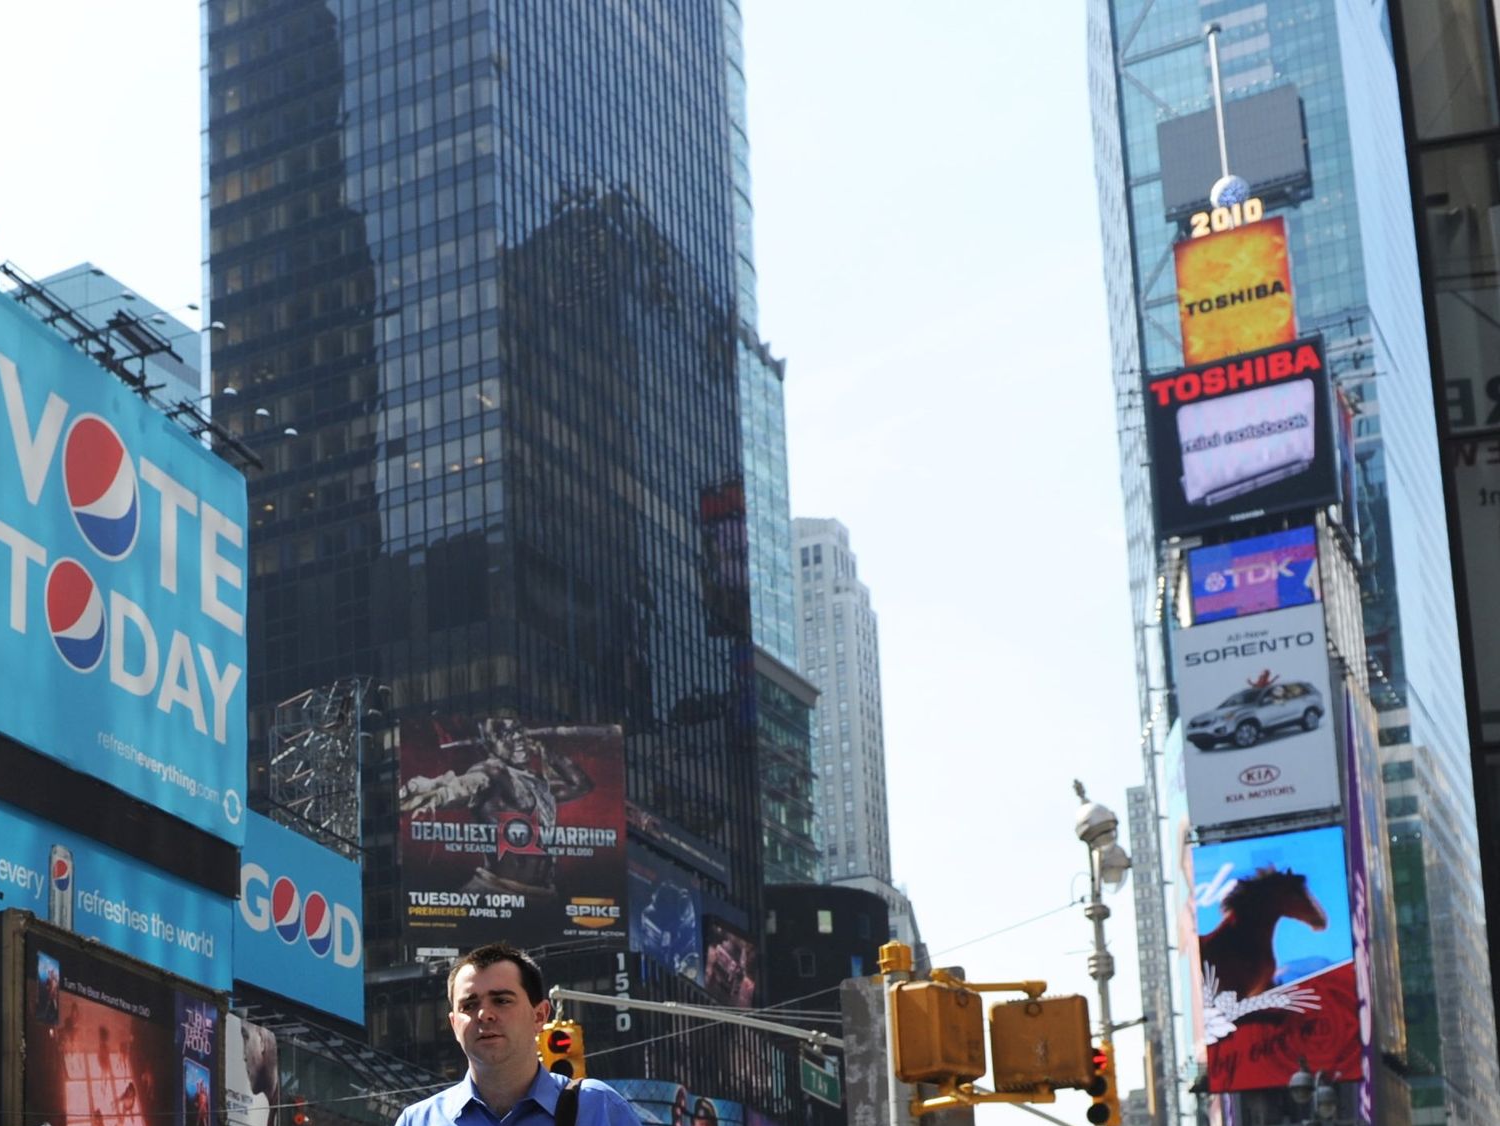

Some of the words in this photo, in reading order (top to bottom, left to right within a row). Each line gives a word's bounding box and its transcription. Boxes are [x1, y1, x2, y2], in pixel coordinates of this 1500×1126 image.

[1190, 198, 1264, 238] 2010
[1185, 279, 1285, 319] TOSHIBA
[1150, 345, 1321, 406] TOSHIBA
[1224, 413, 1309, 446] notebook
[1224, 560, 1295, 588] TDK
[1185, 632, 1315, 667] SORENTO
[1246, 767, 1274, 782] KIA
[1225, 791, 1245, 804] KIA
[1248, 785, 1296, 801] MOTORS
[411, 821, 498, 842] DEADLIEST
[539, 826, 617, 847] WARRIOR
[445, 843, 462, 853] NEW
[464, 844, 497, 854] SEASON
[567, 847, 594, 857] BLOOD
[408, 891, 480, 906] TUESDAY
[485, 893, 526, 908] 10PM
[408, 906, 468, 917] PREMIERES
[469, 908, 498, 918] APRIL
[500, 909, 512, 918] 20
[565, 904, 621, 918] SPIKE
[77, 889, 148, 935] refreshes
[151, 913, 175, 945] the
[177, 927, 215, 959] world
